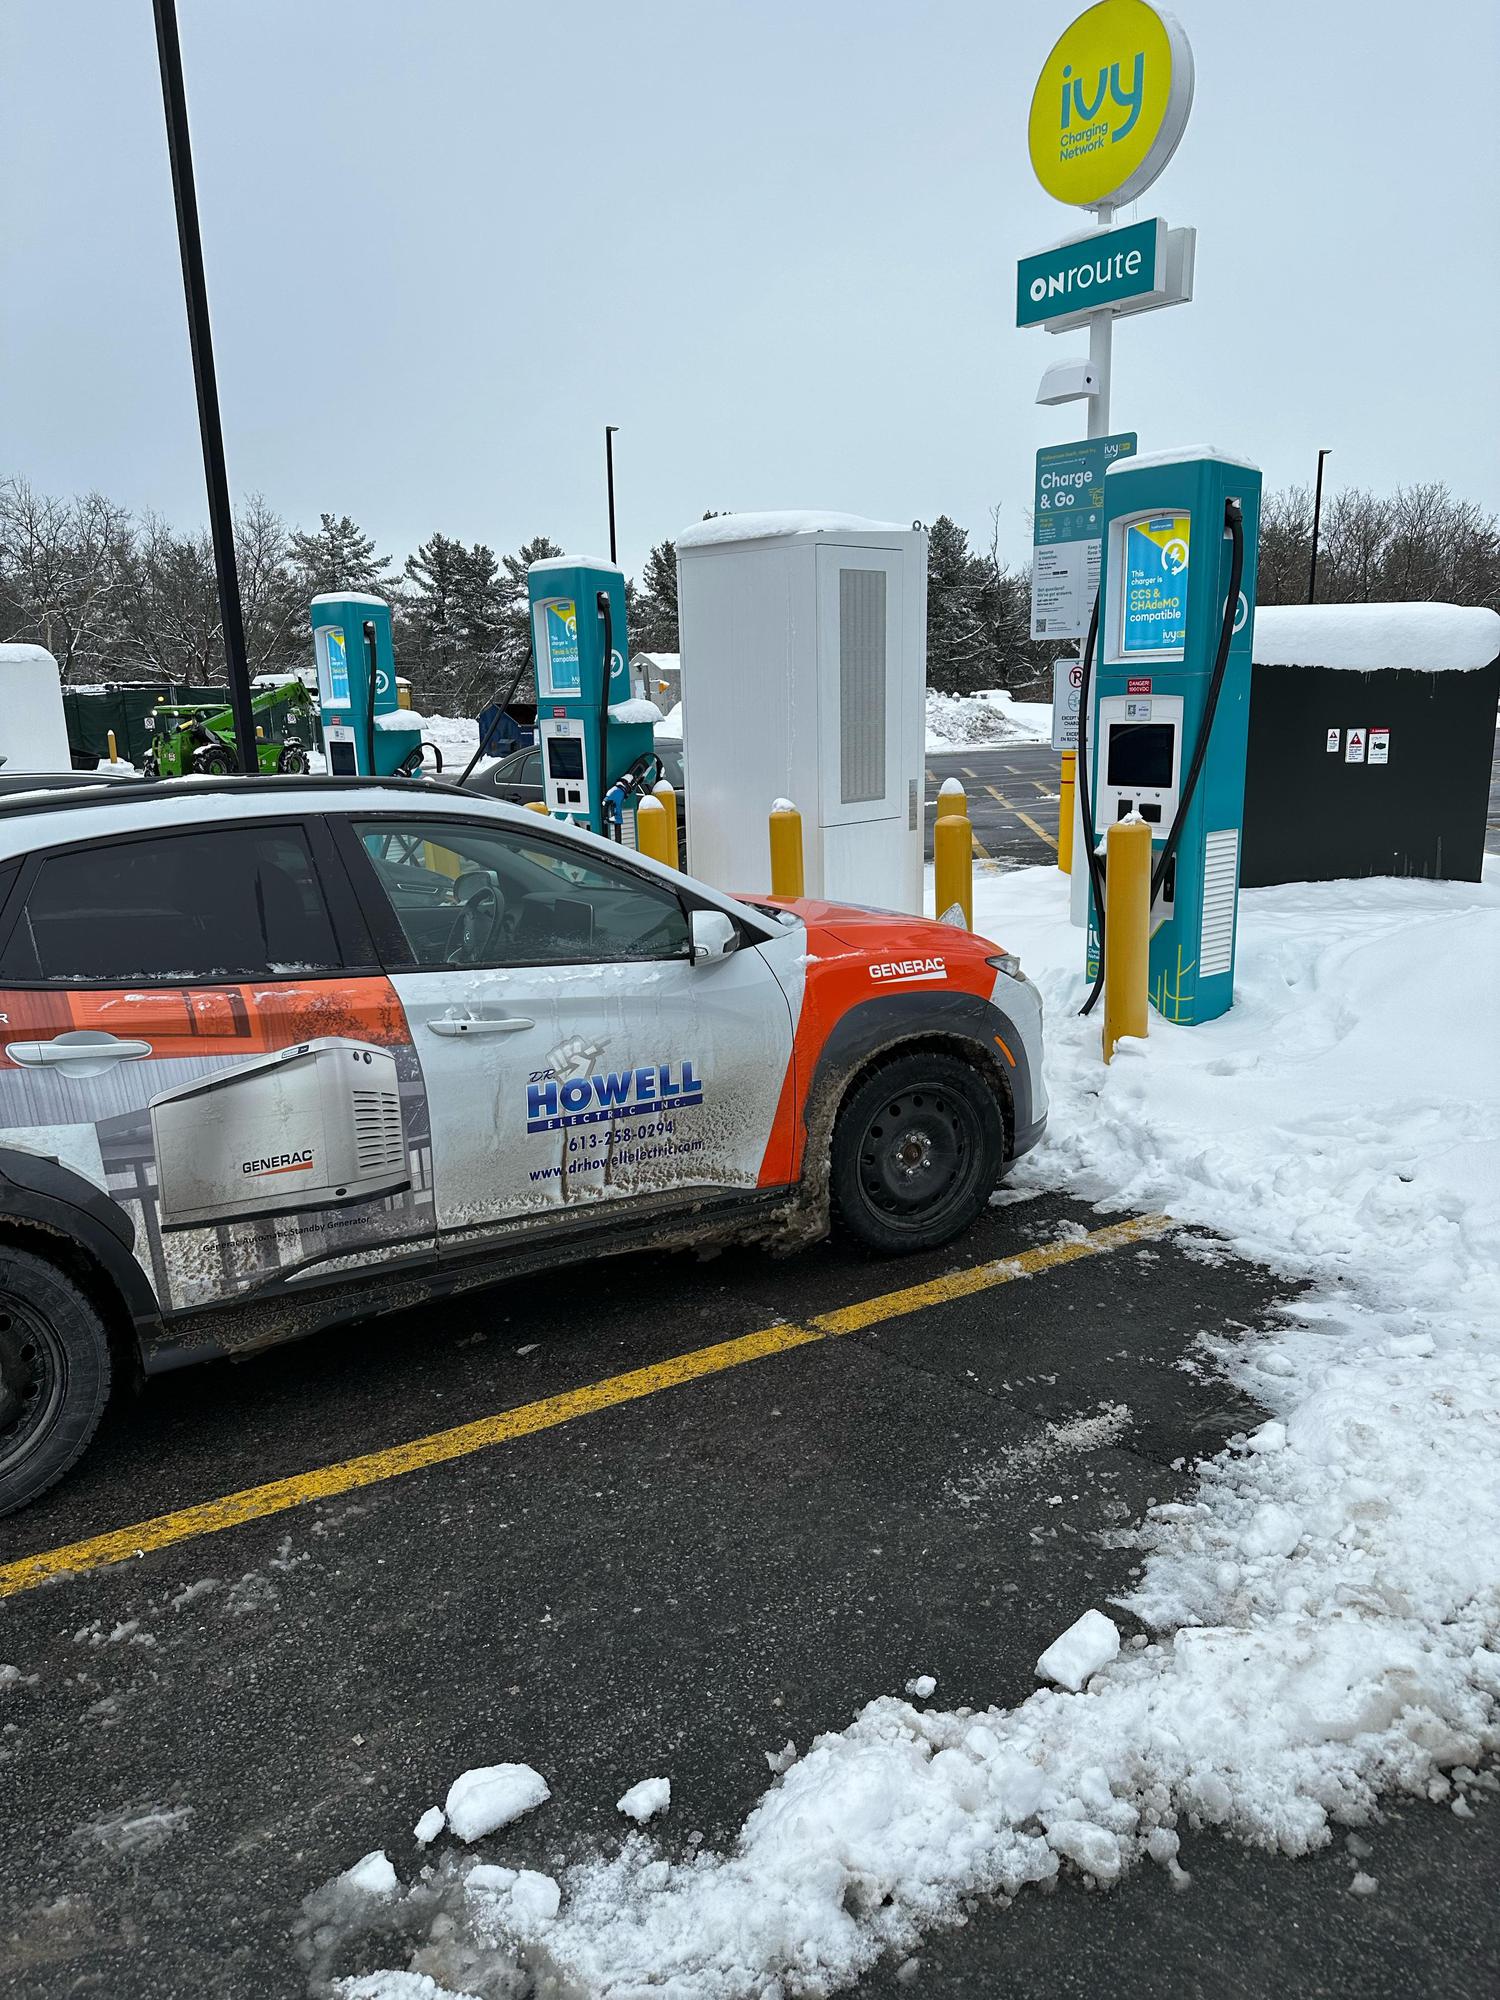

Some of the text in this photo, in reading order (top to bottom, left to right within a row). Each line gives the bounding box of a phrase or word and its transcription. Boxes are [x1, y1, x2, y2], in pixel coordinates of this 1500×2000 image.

[1061, 52, 1144, 143] ivy
[1060, 121, 1109, 147] Charging
[1060, 136, 1105, 162] Network
[1104, 442, 1119, 458] ivy
[1040, 471, 1093, 489] Charge
[1040, 491, 1075, 509] & Go
[1131, 570, 1145, 578] This
[1131, 575, 1163, 586] charger is
[1130, 588, 1161, 600] CCS &
[1130, 609, 1182, 623] compatible
[1162, 629, 1177, 643] ivy
[868, 957, 945, 978] GENERAC
[526, 1060, 703, 1121] HOWELL
[547, 1098, 687, 1129] ELECTRIC INC.
[569, 1121, 673, 1152] 613-258-0294
[242, 1149, 313, 1174] GENERAC
[529, 1139, 703, 1182] www.drhowellelectric.com
[203, 1216, 370, 1253] Generac Automatic Standby Generator
